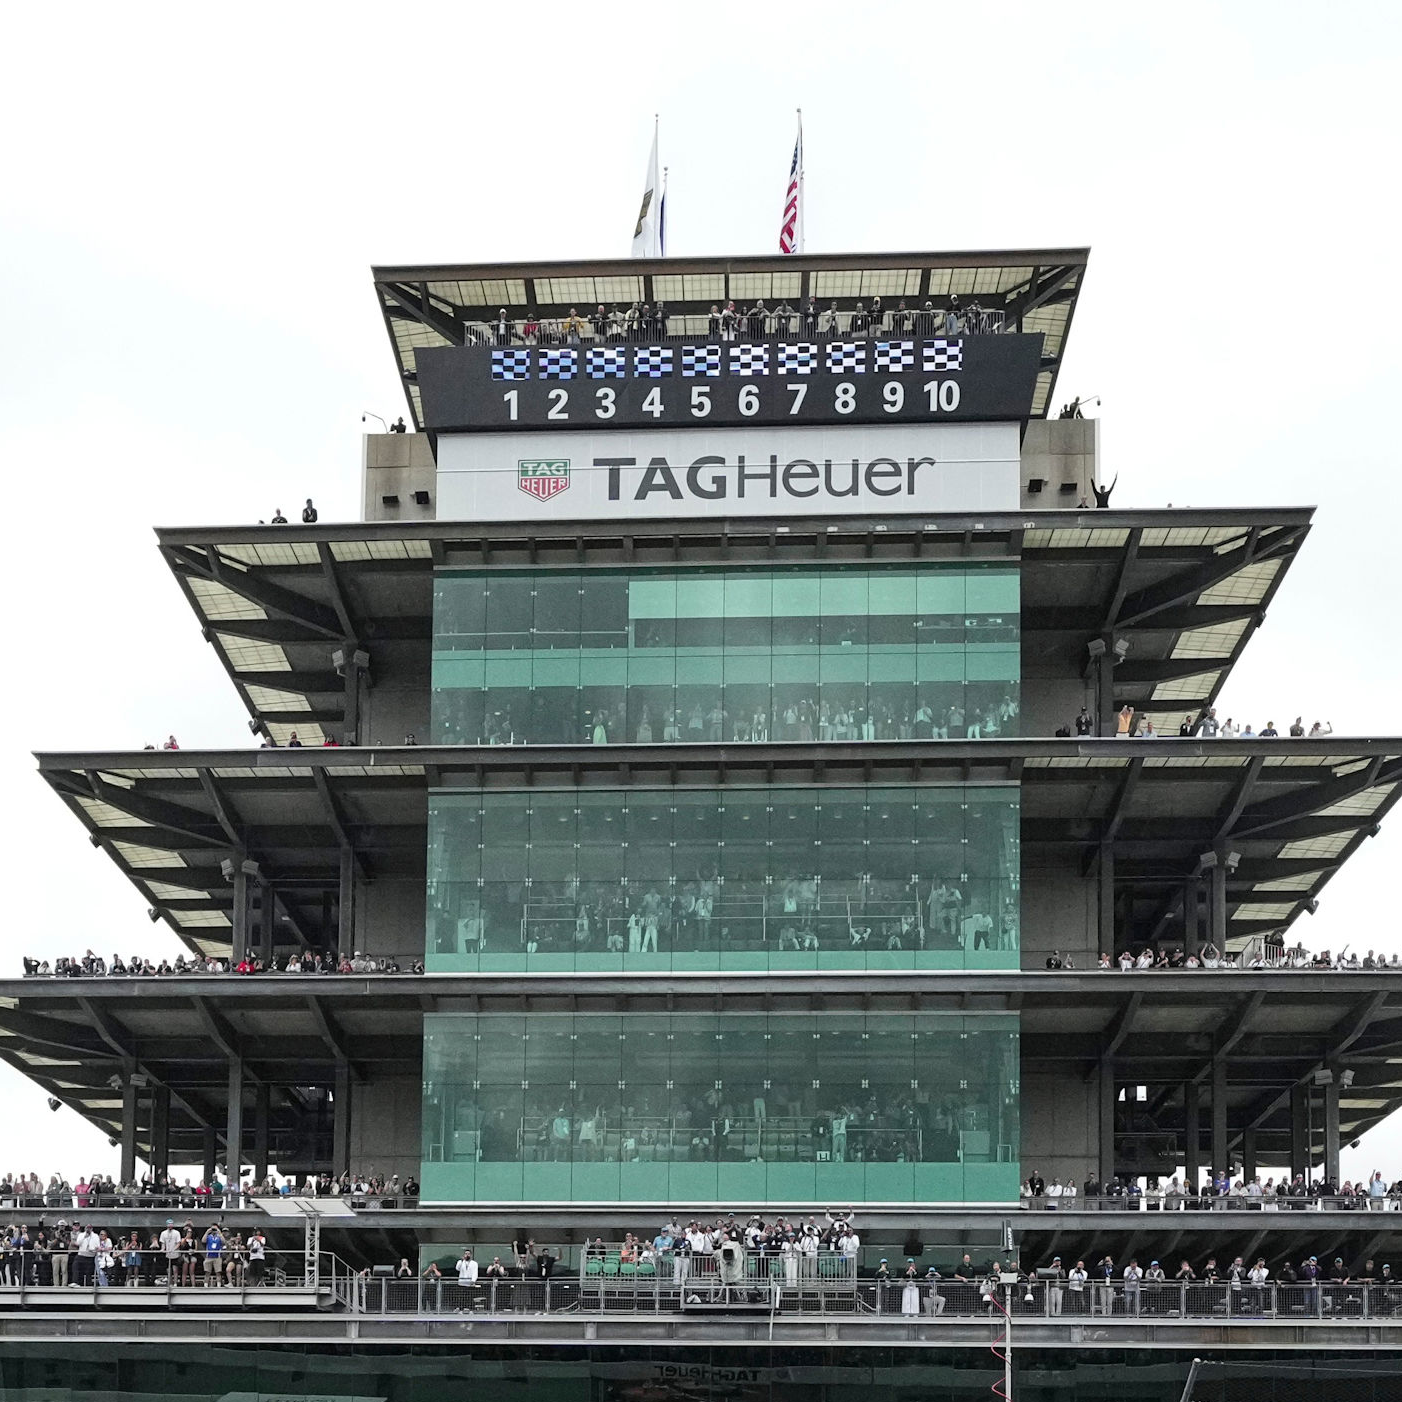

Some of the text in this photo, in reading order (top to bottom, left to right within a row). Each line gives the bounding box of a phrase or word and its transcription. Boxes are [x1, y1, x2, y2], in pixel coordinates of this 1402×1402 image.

[503, 379, 961, 421] 1 2 3 4 5 6 7 8 9 10
[523, 462, 565, 476] TAG
[521, 477, 568, 500] HEUER
